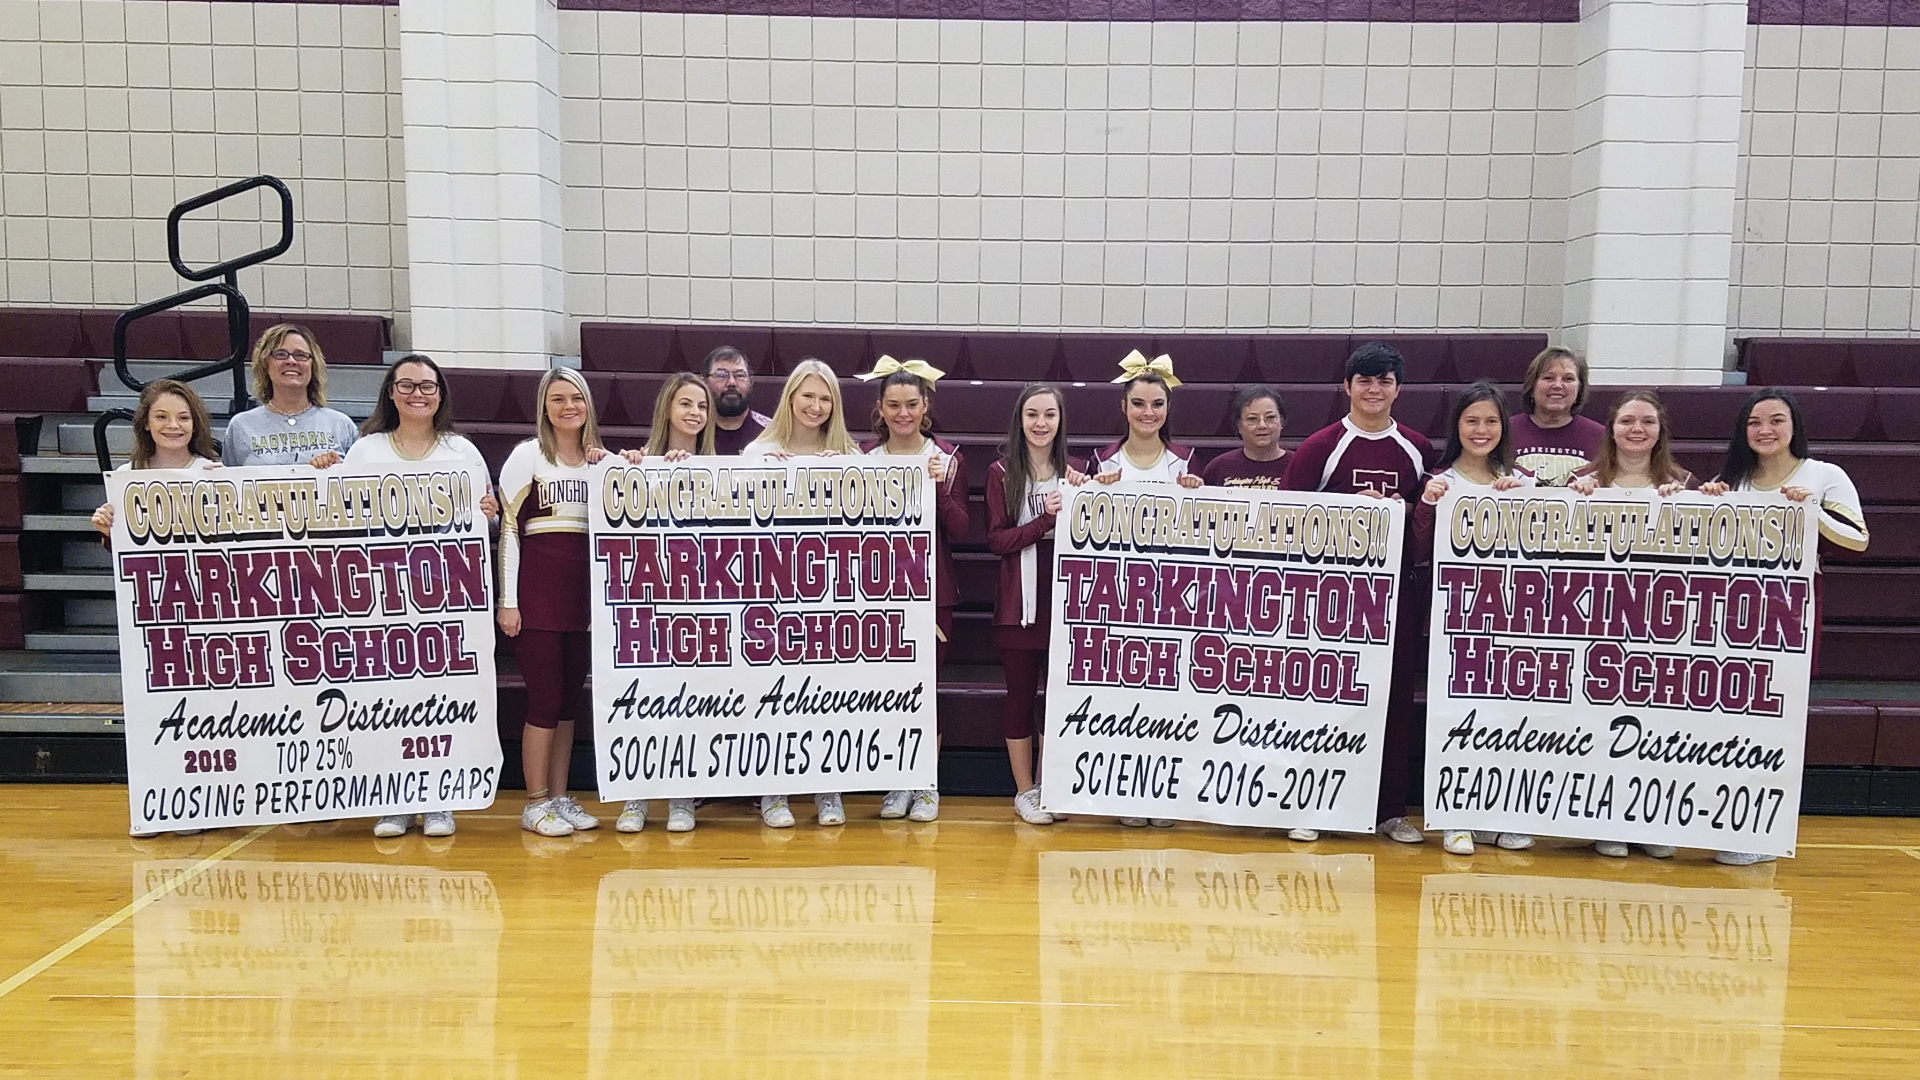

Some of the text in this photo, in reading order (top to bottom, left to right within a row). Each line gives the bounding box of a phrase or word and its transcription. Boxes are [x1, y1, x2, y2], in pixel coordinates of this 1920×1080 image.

[252, 430, 335, 452] LADYHORNS
[1516, 446, 1585, 457] TARKINGTON
[125, 471, 471, 545] CONGRATULATIONS!!
[540, 480, 588, 507] LONGHO
[604, 466, 922, 528] CONGRATULATIONS!!
[1071, 490, 1390, 568] CONGRATULATIONS!!
[1451, 496, 1805, 571] CONGRATULATIONS!!
[118, 538, 489, 626] TARKINGTON
[594, 531, 931, 604] TARKINGTON
[1057, 554, 1394, 646] TARKINGTON
[1438, 562, 1810, 653] TARKINGTON
[145, 618, 478, 691] HIGH SCHOOL
[613, 602, 916, 668] HIGH SCHOOL
[1067, 624, 1369, 706] HIGH SCHOOL
[608, 674, 923, 724] Academic Achievement
[1448, 636, 1783, 718] HIGH SCHOOL
[154, 688, 478, 746] Academic Distinction
[1058, 696, 1367, 755] Academic Distinction
[1442, 709, 1785, 772] Academic Distinction
[184, 734, 452, 775] 2016 TOP 25% 2017
[609, 728, 923, 782] SOCIAL STUDIES 2016-17
[1072, 751, 1346, 810] SCIENCE 2016-2017
[143, 766, 494, 822] CLOSING PERFORMANCE GAPS
[1436, 767, 1784, 834] READING/ELA 2016-2017
